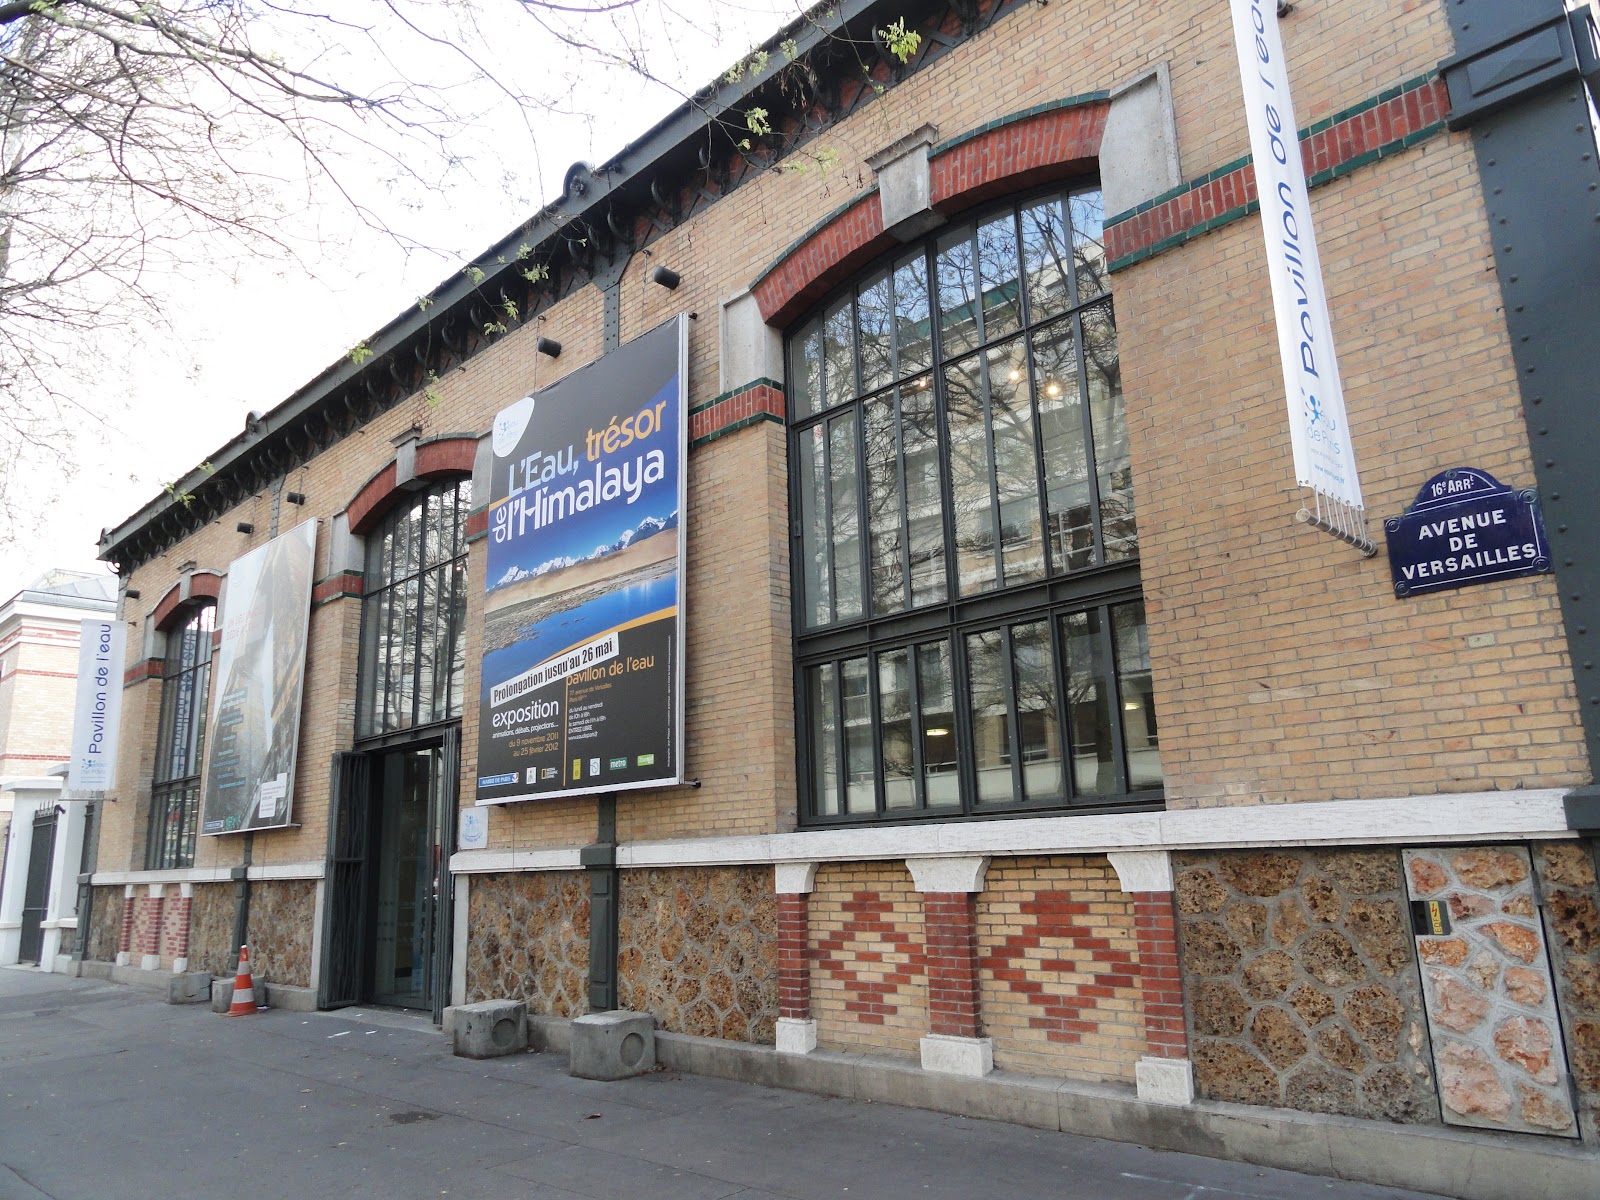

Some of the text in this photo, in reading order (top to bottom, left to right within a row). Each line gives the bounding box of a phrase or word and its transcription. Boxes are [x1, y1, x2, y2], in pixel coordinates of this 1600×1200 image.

[1266, 103, 1286, 165] de
[1278, 181, 1319, 378] Pavillon
[509, 445, 579, 497] L'Eau,
[586, 400, 667, 463] trésor
[492, 450, 665, 544] de l'Himalaya
[1418, 509, 1507, 541] AVENUE
[1449, 533, 1478, 552] DE
[1401, 543, 1537, 580] VERSAILLES
[96, 624, 112, 661] l'eau
[97, 666, 109, 687] de
[493, 637, 613, 703] Prolongation jusqu'au 26 mai
[566, 655, 655, 687] pavillon de l'eau
[88, 692, 107, 754] Pavillon
[492, 700, 559, 730] exposition
[508, 731, 559, 748] du 9 novembre 2011
[520, 747, 529, 756] 25
[529, 745, 545, 756] février
[545, 742, 559, 752] 2012
